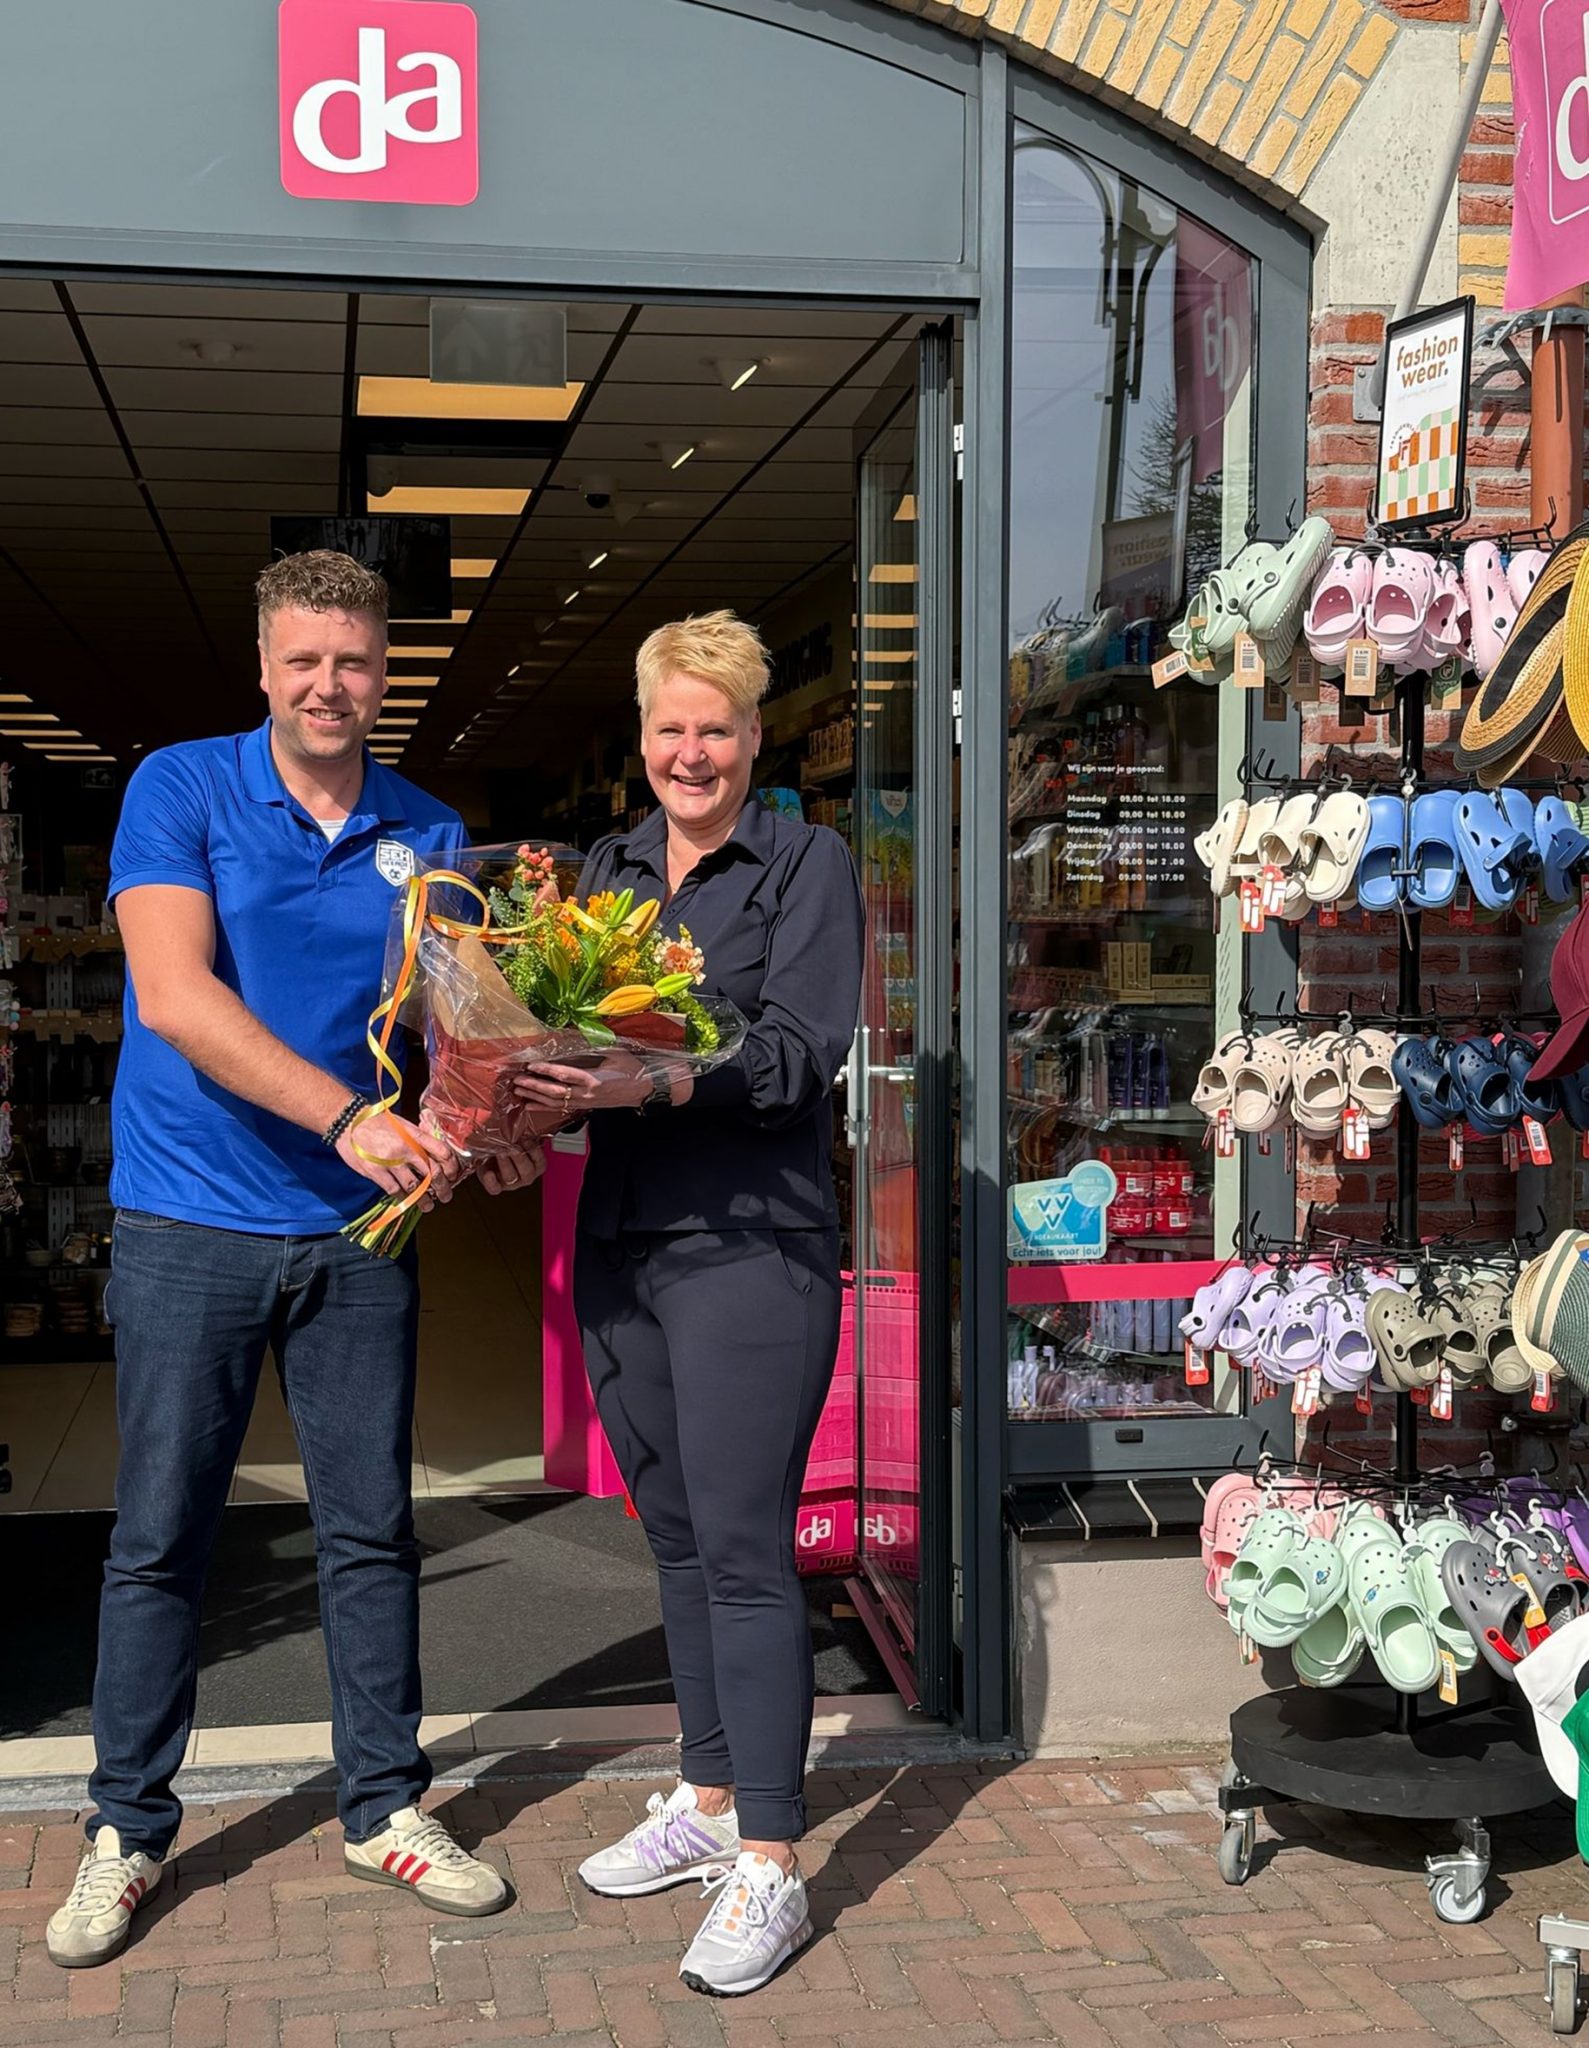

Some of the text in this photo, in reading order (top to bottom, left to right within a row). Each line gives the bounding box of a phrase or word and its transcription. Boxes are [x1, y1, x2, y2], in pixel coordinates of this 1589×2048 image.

[293, 26, 462, 174] da
[1396, 335, 1458, 372] fashion
[1401, 360, 1449, 389] wear.
[1066, 764, 1080, 774] Wij
[1082, 764, 1096, 774] zijn
[1116, 764, 1124, 774] je
[1126, 764, 1165, 774] geopend:
[1067, 794, 1107, 805] Maandag
[1147, 795, 1158, 803] tot
[1066, 810, 1101, 820] Dinsdag
[1146, 811, 1158, 819] tot
[1066, 824, 1109, 836] Woensdag
[1146, 826, 1158, 834] tot
[1066, 841, 1113, 851] Donderdag
[1146, 842, 1158, 850] tot
[1066, 857, 1096, 867] Vrijdag
[1146, 858, 1158, 866] tot
[1066, 873, 1105, 883] Zaterdag
[1145, 873, 1157, 881] tot
[1012, 1247, 1034, 1257] Echt
[1036, 1247, 1054, 1257] iets
[1057, 1247, 1079, 1256] voor
[799, 1515, 831, 1547] da
